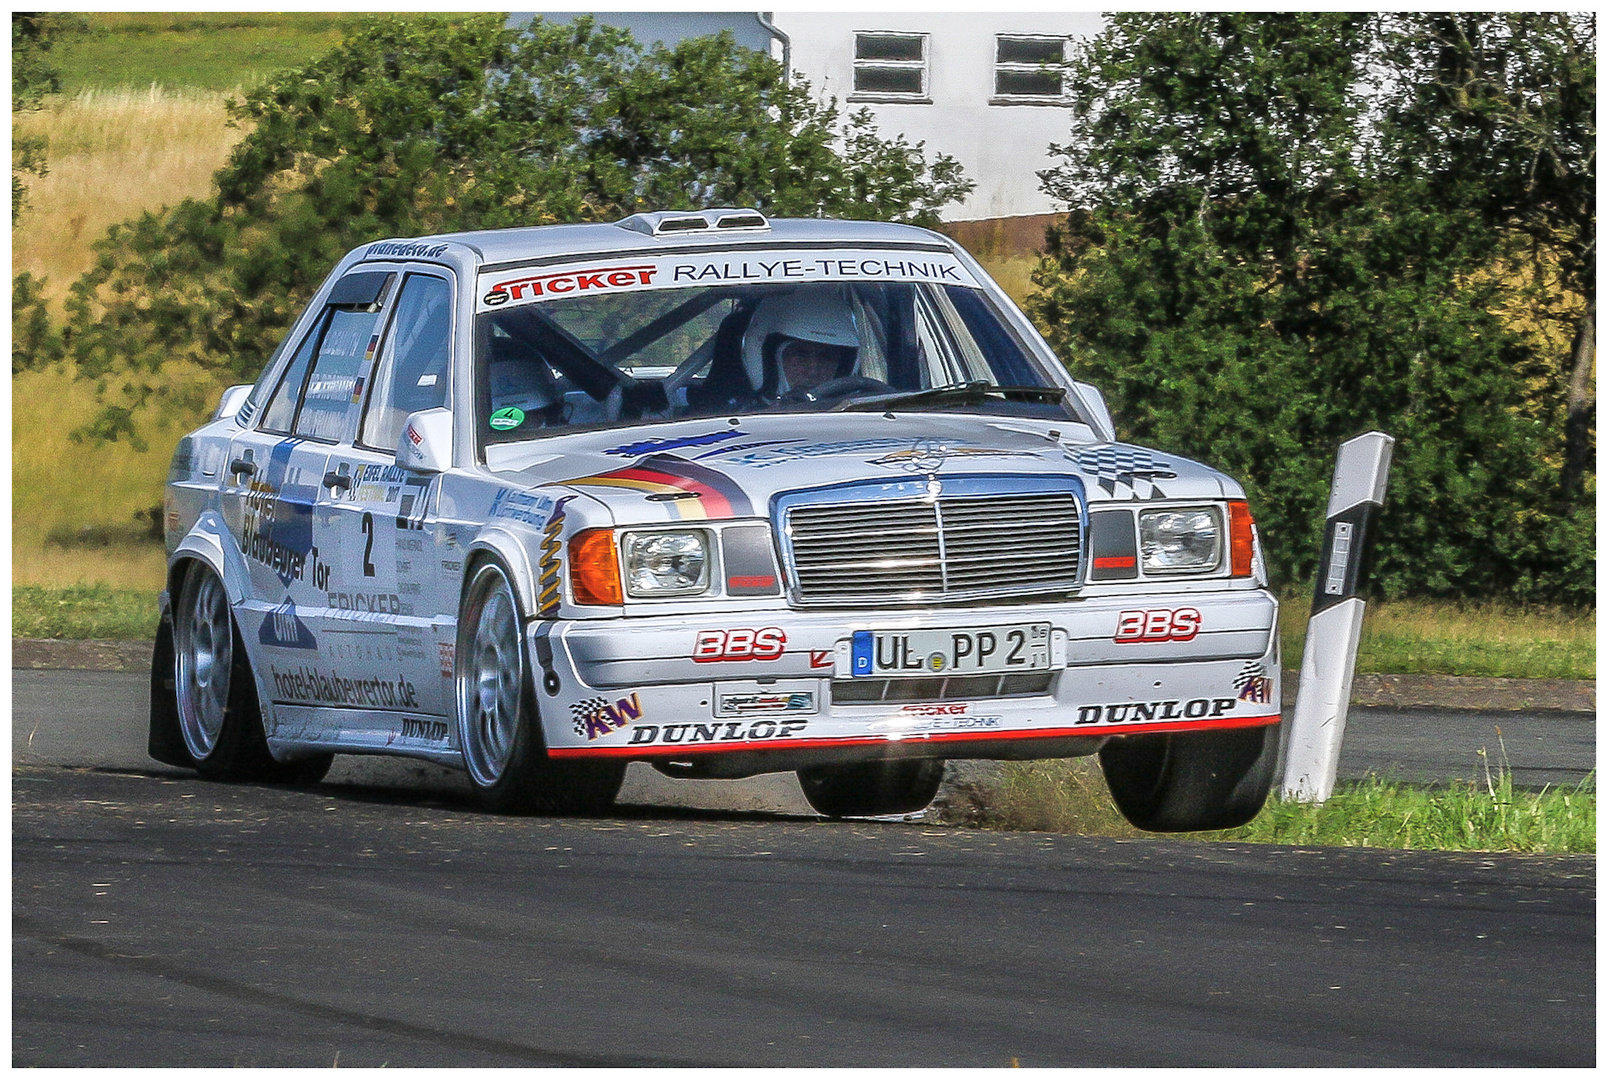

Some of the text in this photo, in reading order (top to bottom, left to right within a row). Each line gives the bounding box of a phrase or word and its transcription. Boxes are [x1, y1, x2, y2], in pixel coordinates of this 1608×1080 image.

[673, 259, 962, 281] RALLYE-TECHNIK
[503, 408, 514, 419] 4
[363, 464, 382, 482] EIFEL
[362, 512, 375, 576] 2
[311, 546, 331, 592] Tor
[1113, 608, 1203, 644] BBS
[692, 627, 788, 663] BBS
[875, 630, 1026, 670] UL PP 2
[857, 657, 868, 668] D
[271, 664, 420, 709] hotel-blaubeurertor.de
[587, 692, 645, 741] KW
[1075, 698, 1238, 725] DUNLOP
[400, 718, 448, 740] DUNLOP
[627, 719, 809, 745] DUNLOP
